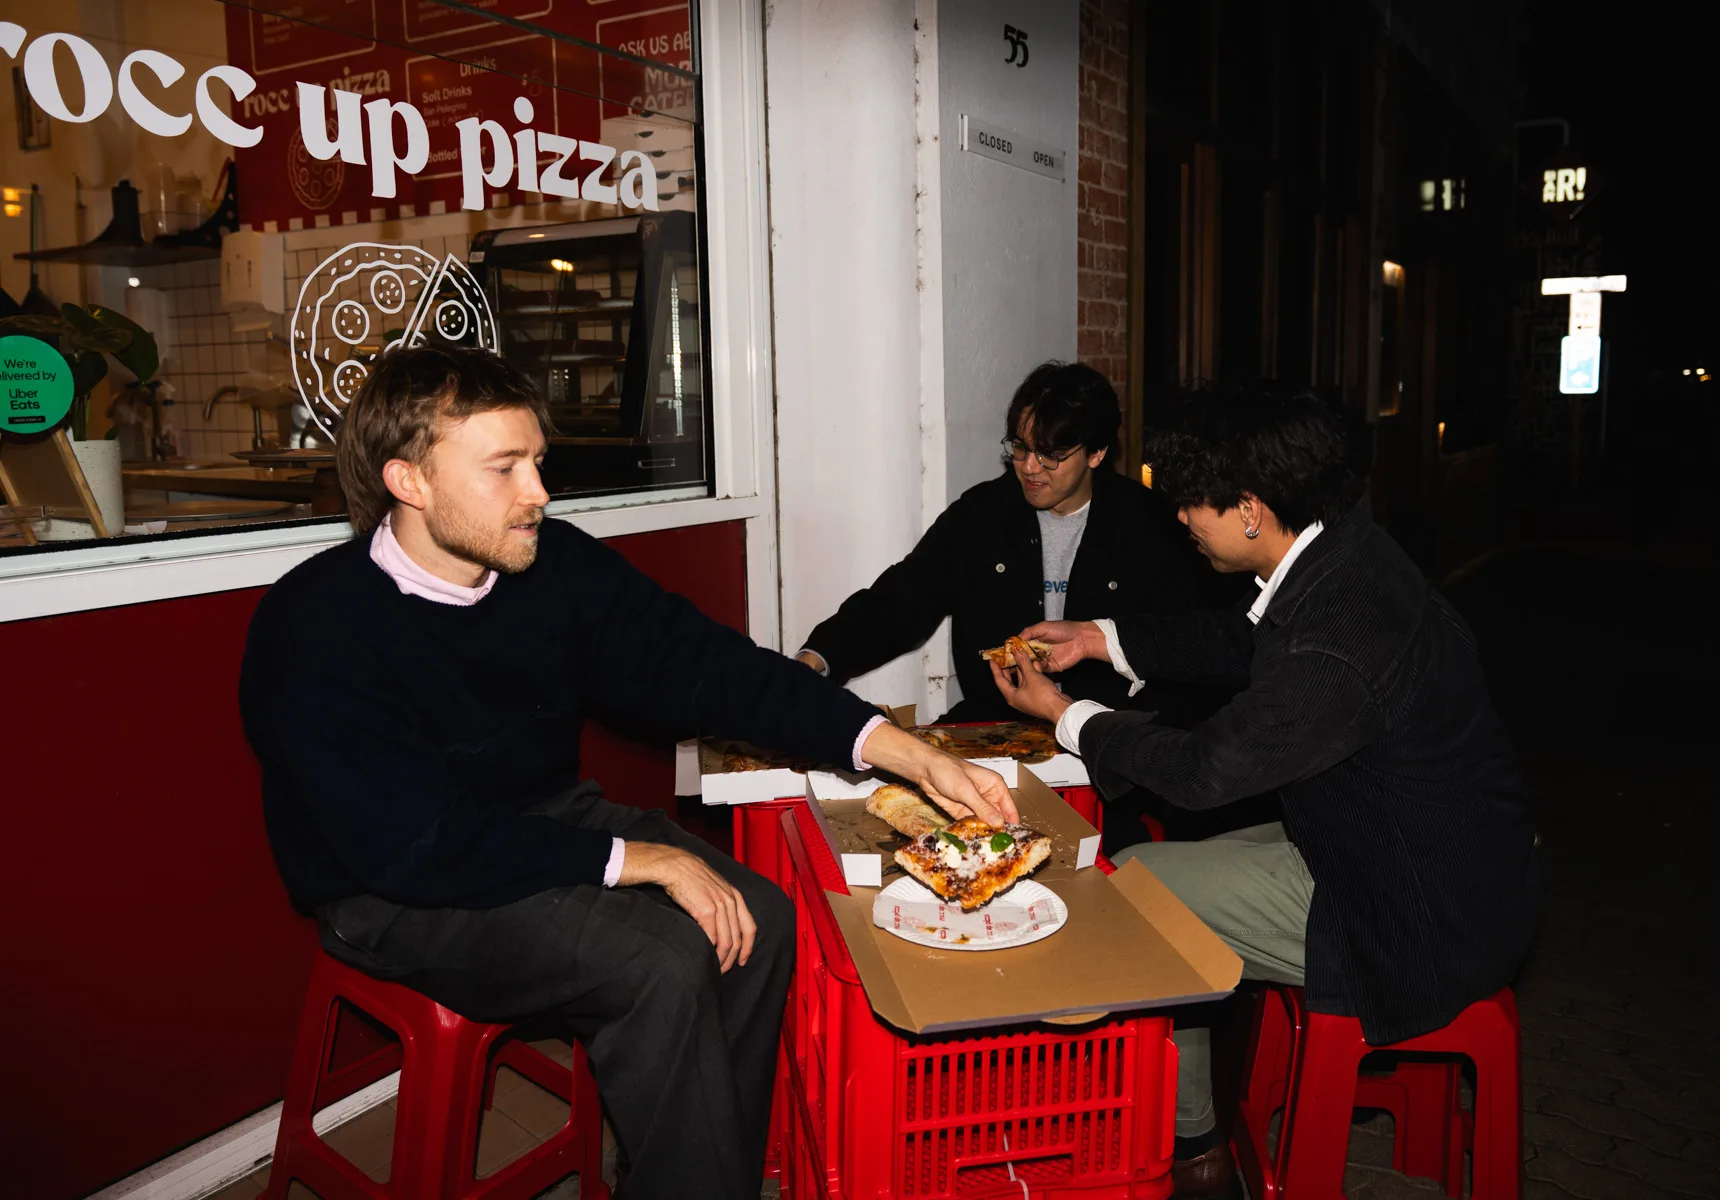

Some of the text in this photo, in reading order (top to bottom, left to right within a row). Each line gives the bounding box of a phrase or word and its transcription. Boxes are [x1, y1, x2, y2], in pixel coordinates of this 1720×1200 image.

[649, 34, 669, 55] US
[1004, 24, 1030, 68] 55
[460, 56, 497, 78] Drinks
[243, 88, 291, 119] rocc
[421, 85, 472, 103] Soft Drinks
[296, 81, 430, 199] up
[455, 97, 659, 212] pizza
[979, 131, 1054, 168] CLOSED OPEN
[4, 359, 37, 369] We're
[42, 371, 57, 382] by
[9, 388, 38, 399] Uber
[10, 400, 41, 410] Eats
